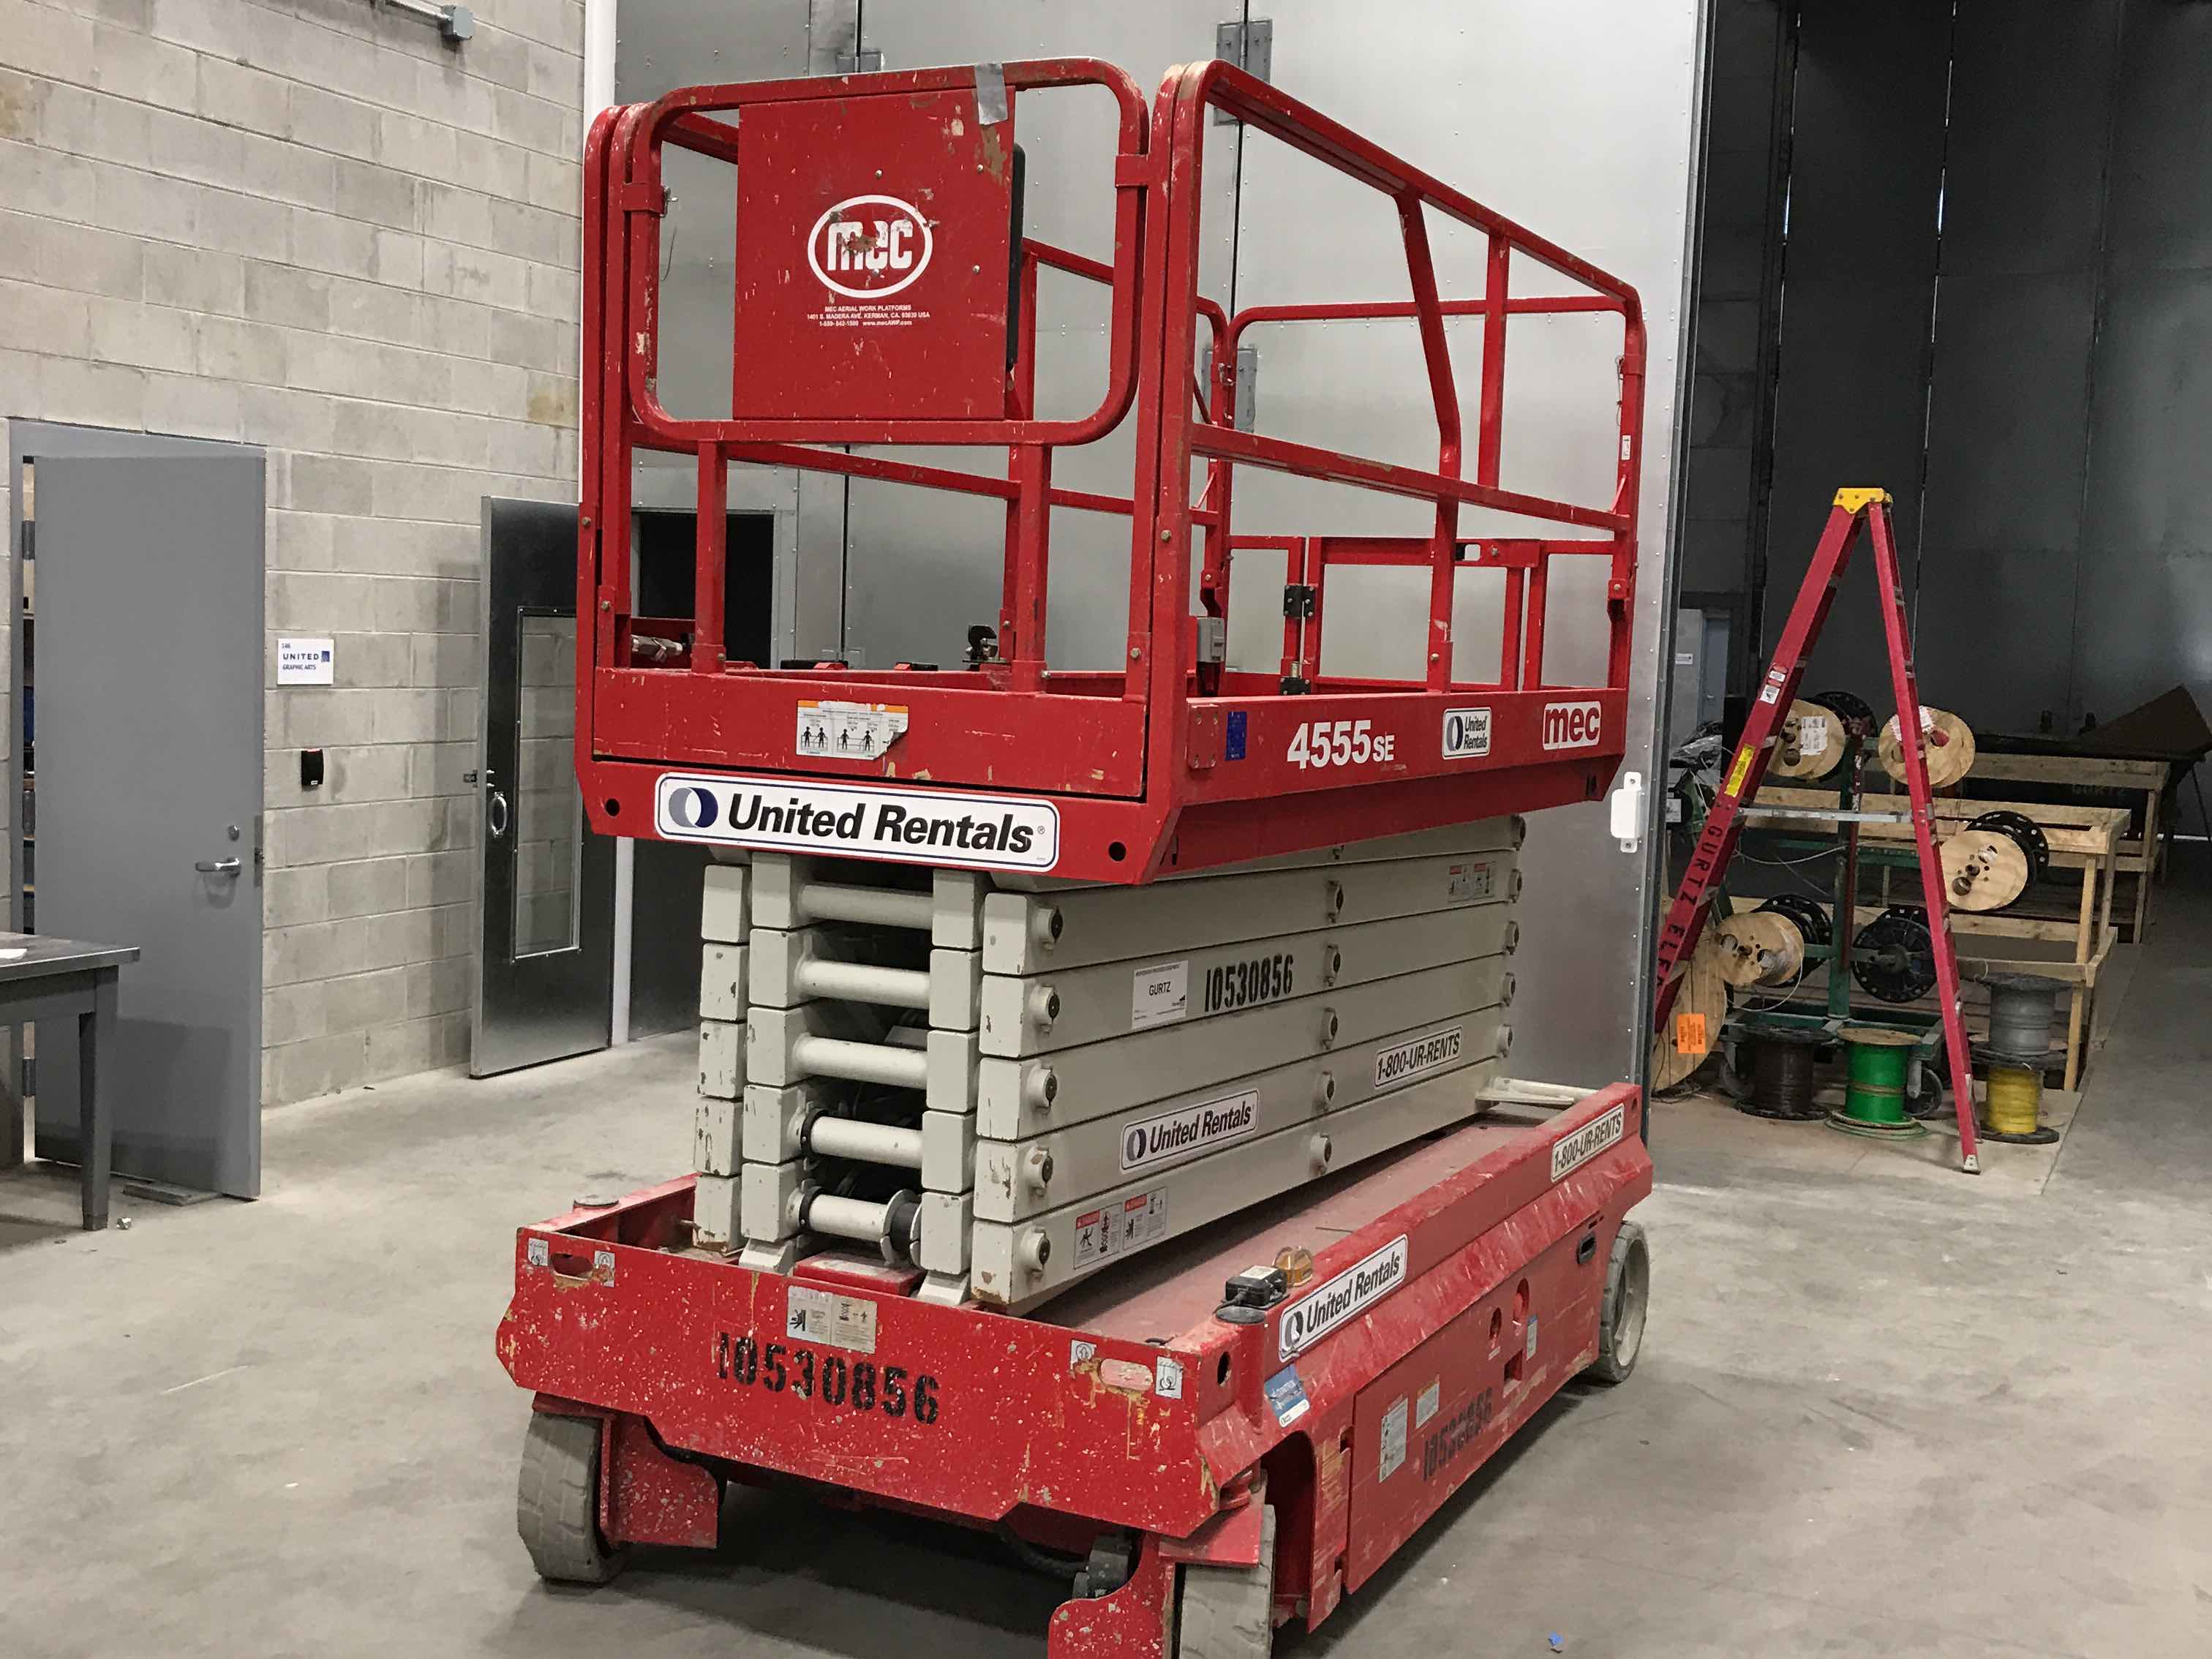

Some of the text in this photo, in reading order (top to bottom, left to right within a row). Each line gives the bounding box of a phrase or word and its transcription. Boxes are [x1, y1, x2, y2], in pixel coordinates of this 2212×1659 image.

[1464, 715, 1487, 732] United
[1464, 733, 1487, 750] Rentals
[729, 793, 1034, 854] United Rentals
[1680, 825, 1723, 906] GURTZ
[1148, 981, 1171, 996] GURTZ
[1205, 953, 1294, 1013] 10530856
[1377, 1032, 1460, 1080] 1-800-UR-RENTS
[1149, 1101, 1252, 1154] United Rentals
[1554, 1112, 1622, 1172] 1-800-UR-RENTS
[1306, 1252, 1401, 1333] United Rentals
[719, 1331, 939, 1425] 10530856
